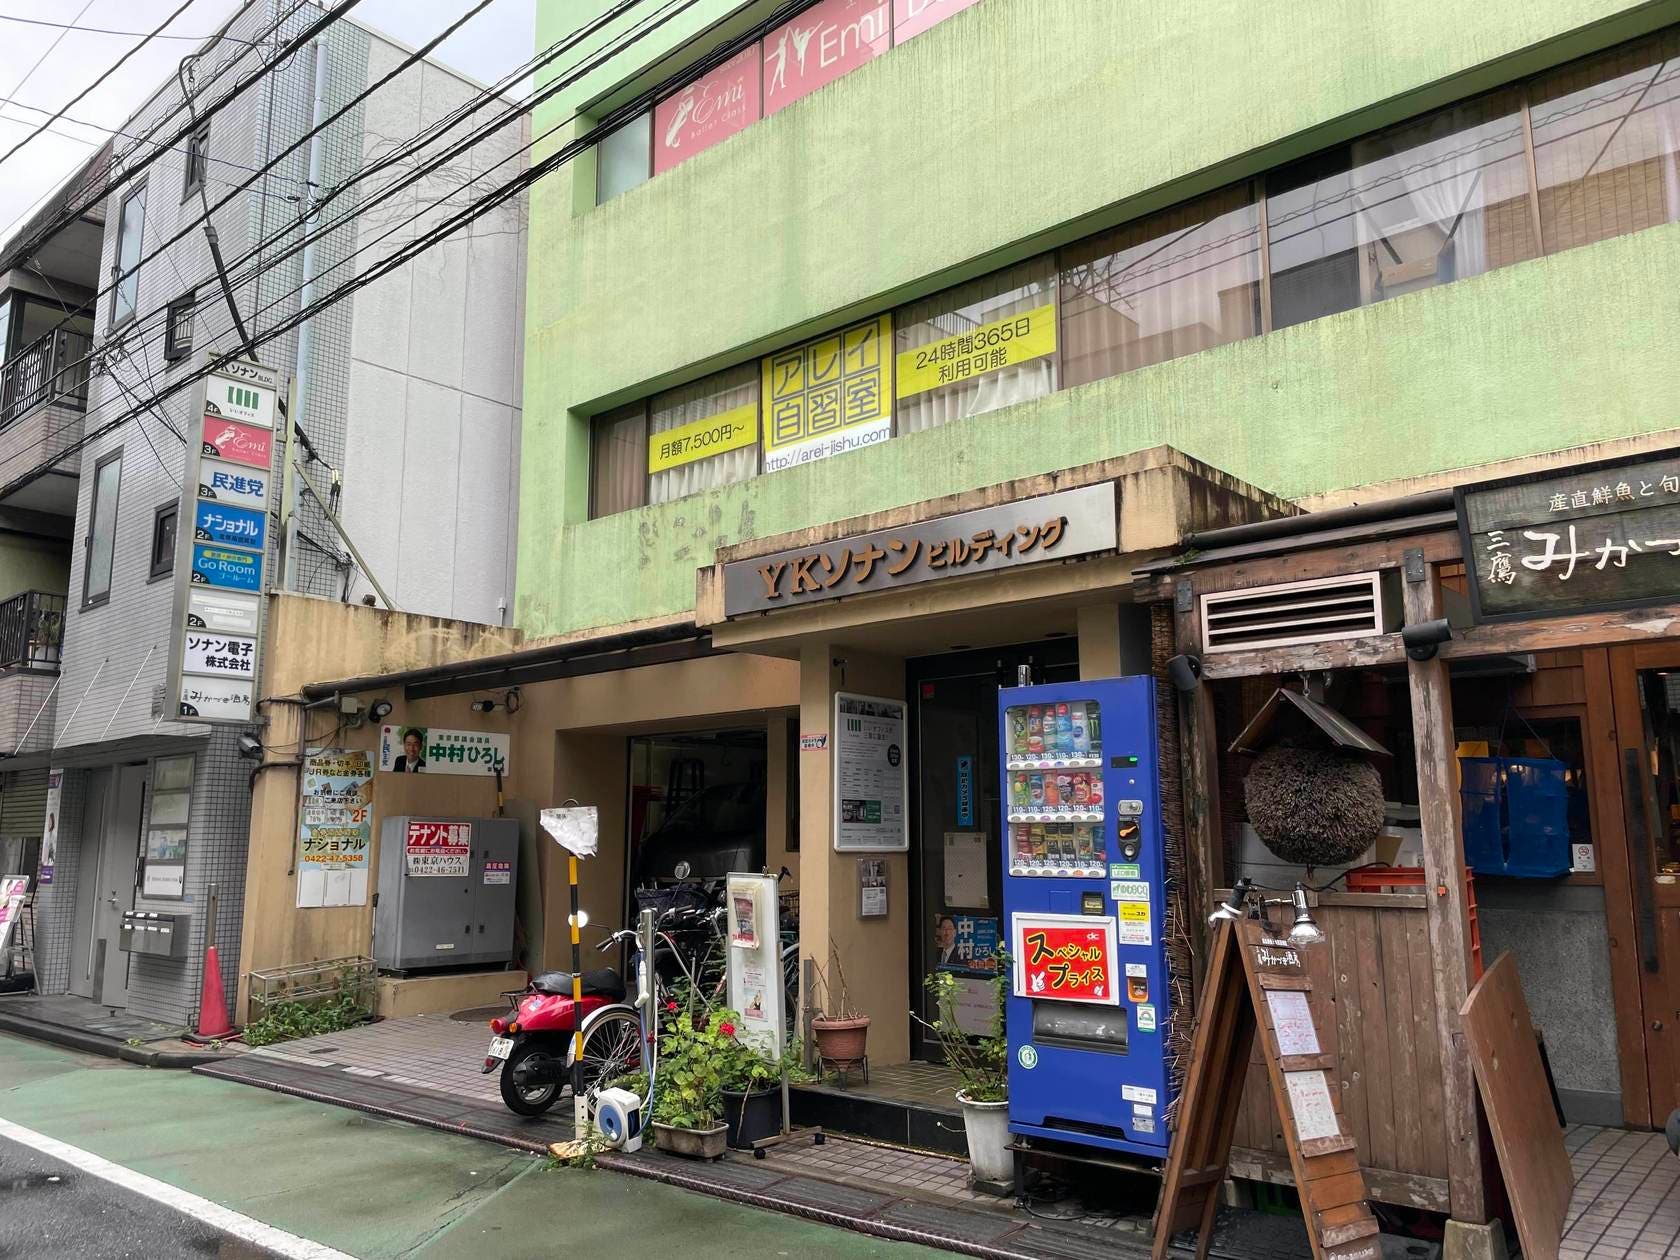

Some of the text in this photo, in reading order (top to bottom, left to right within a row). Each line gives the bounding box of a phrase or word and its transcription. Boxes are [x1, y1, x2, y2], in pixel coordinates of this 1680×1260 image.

[820, 0, 884, 68] Emi
[916, 319, 1030, 369] 24時間365日
[776, 328, 873, 394] アレイ
[939, 348, 1007, 383] 利用可能
[207, 404, 218, 413] 4F
[776, 376, 877, 438] 自習室
[204, 446, 217, 456] 3F
[200, 487, 213, 497] 3F
[211, 471, 264, 497] 民進党
[1549, 475, 1679, 513] 産直鮮魚と旬
[197, 530, 209, 539] 2F
[203, 513, 258, 536] ナショナル
[198, 558, 255, 575] Go Room
[1486, 531, 1516, 585] 三鷹
[193, 573, 206, 583] 2F
[189, 617, 202, 627] 2F
[188, 637, 253, 656] ソナン電子
[205, 655, 251, 671] 株式会社
[183, 706, 195, 716] 1F
[352, 808, 368, 822] 2F
[304, 838, 366, 851] ナショナル
[409, 824, 469, 845] テナント募集
[1027, 932, 1101, 964] スペシャル
[1048, 962, 1104, 989] プライス
